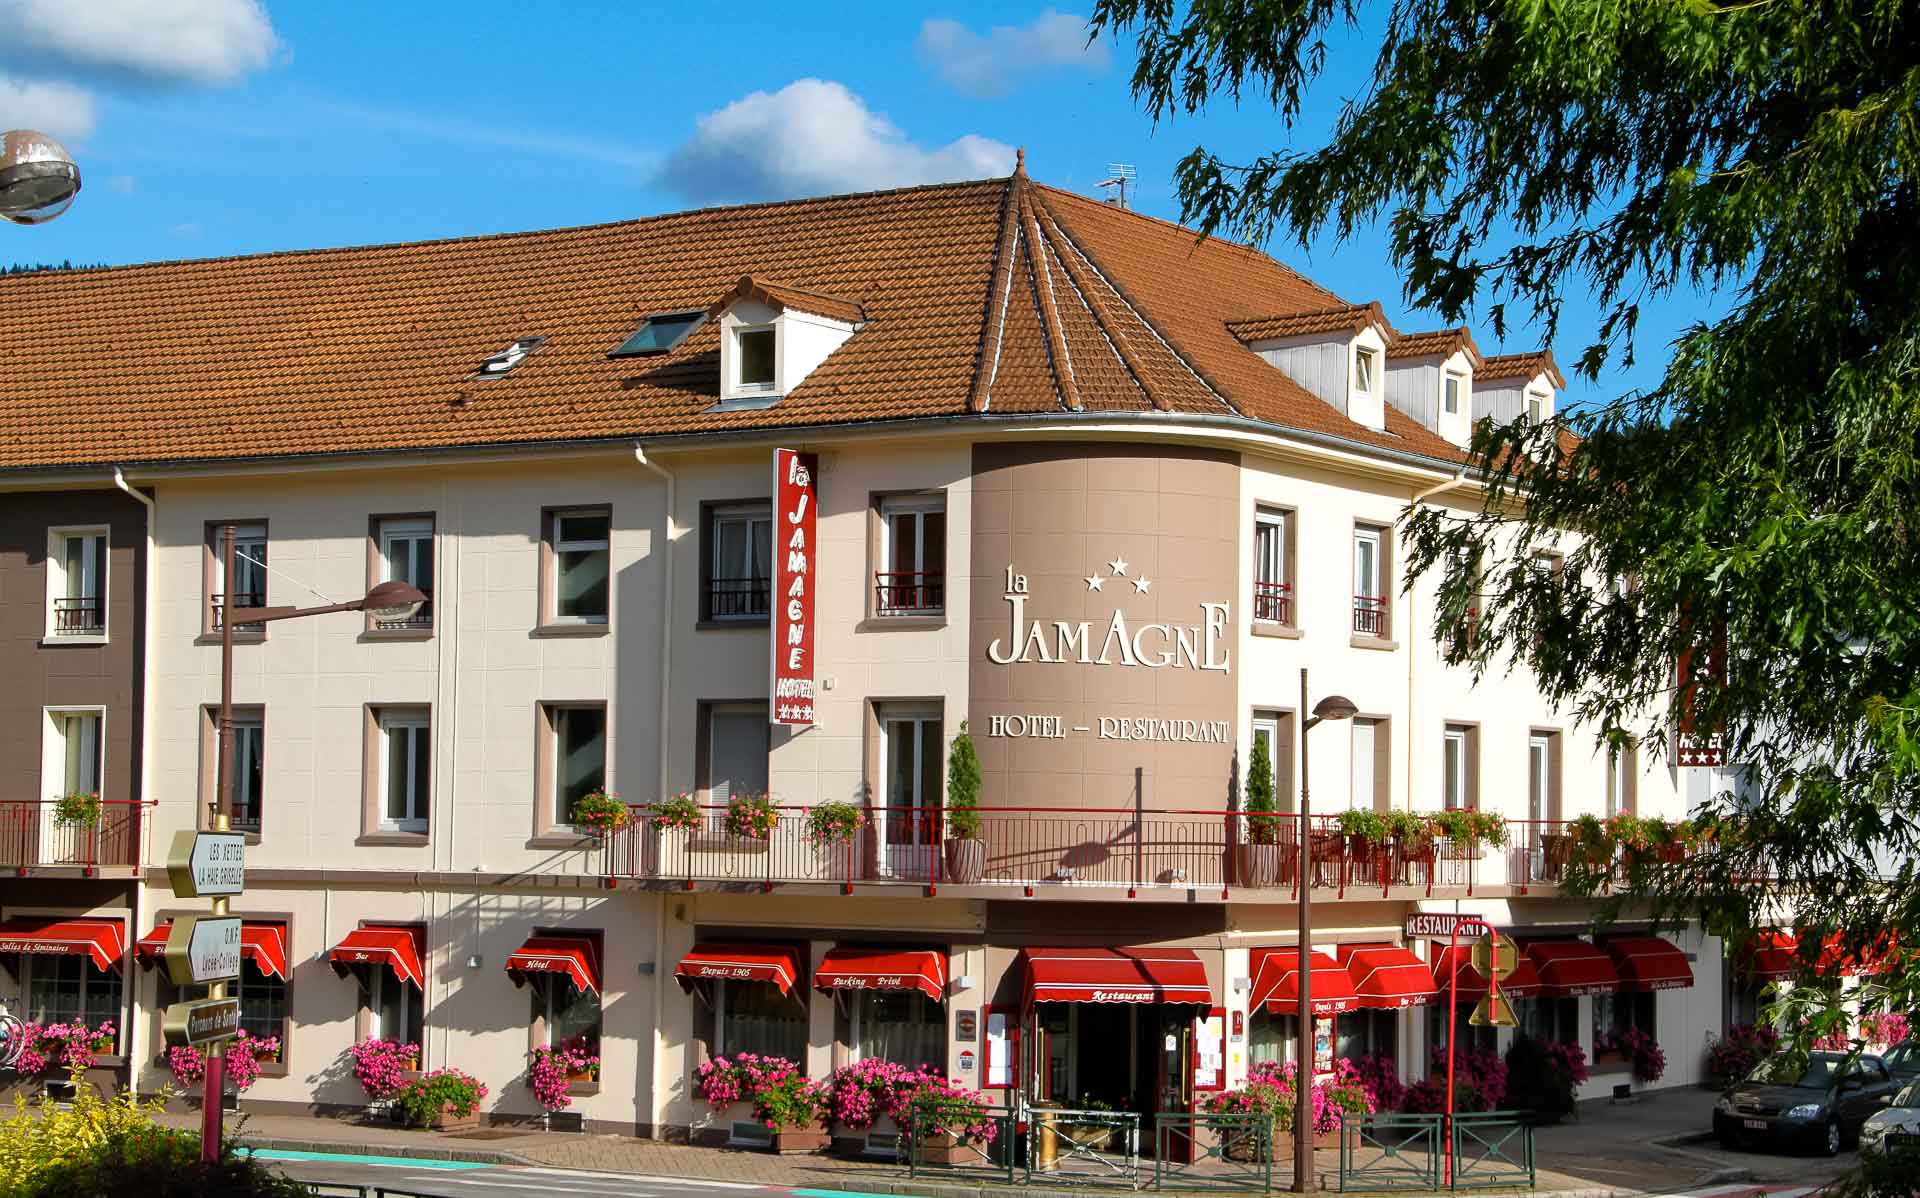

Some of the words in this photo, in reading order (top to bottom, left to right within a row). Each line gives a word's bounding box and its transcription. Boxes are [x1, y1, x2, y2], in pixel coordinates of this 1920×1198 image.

[787, 494, 808, 670] JAMAGNE
[1005, 563, 1029, 594] la
[987, 595, 1231, 676] JAMAGNE
[989, 714, 1067, 740] HOTEL
[1097, 715, 1231, 744] RESTAURANT
[208, 843, 220, 861] LES
[199, 867, 206, 886] LA
[206, 867, 219, 885] HAIE
[1408, 915, 1482, 936] RESTAURANT
[22, 943, 32, 951] de
[701, 966, 729, 977] Depuis
[732, 968, 752, 977] 1905
[832, 976, 866, 989] Parking
[1091, 990, 1155, 1001] Restaurant
